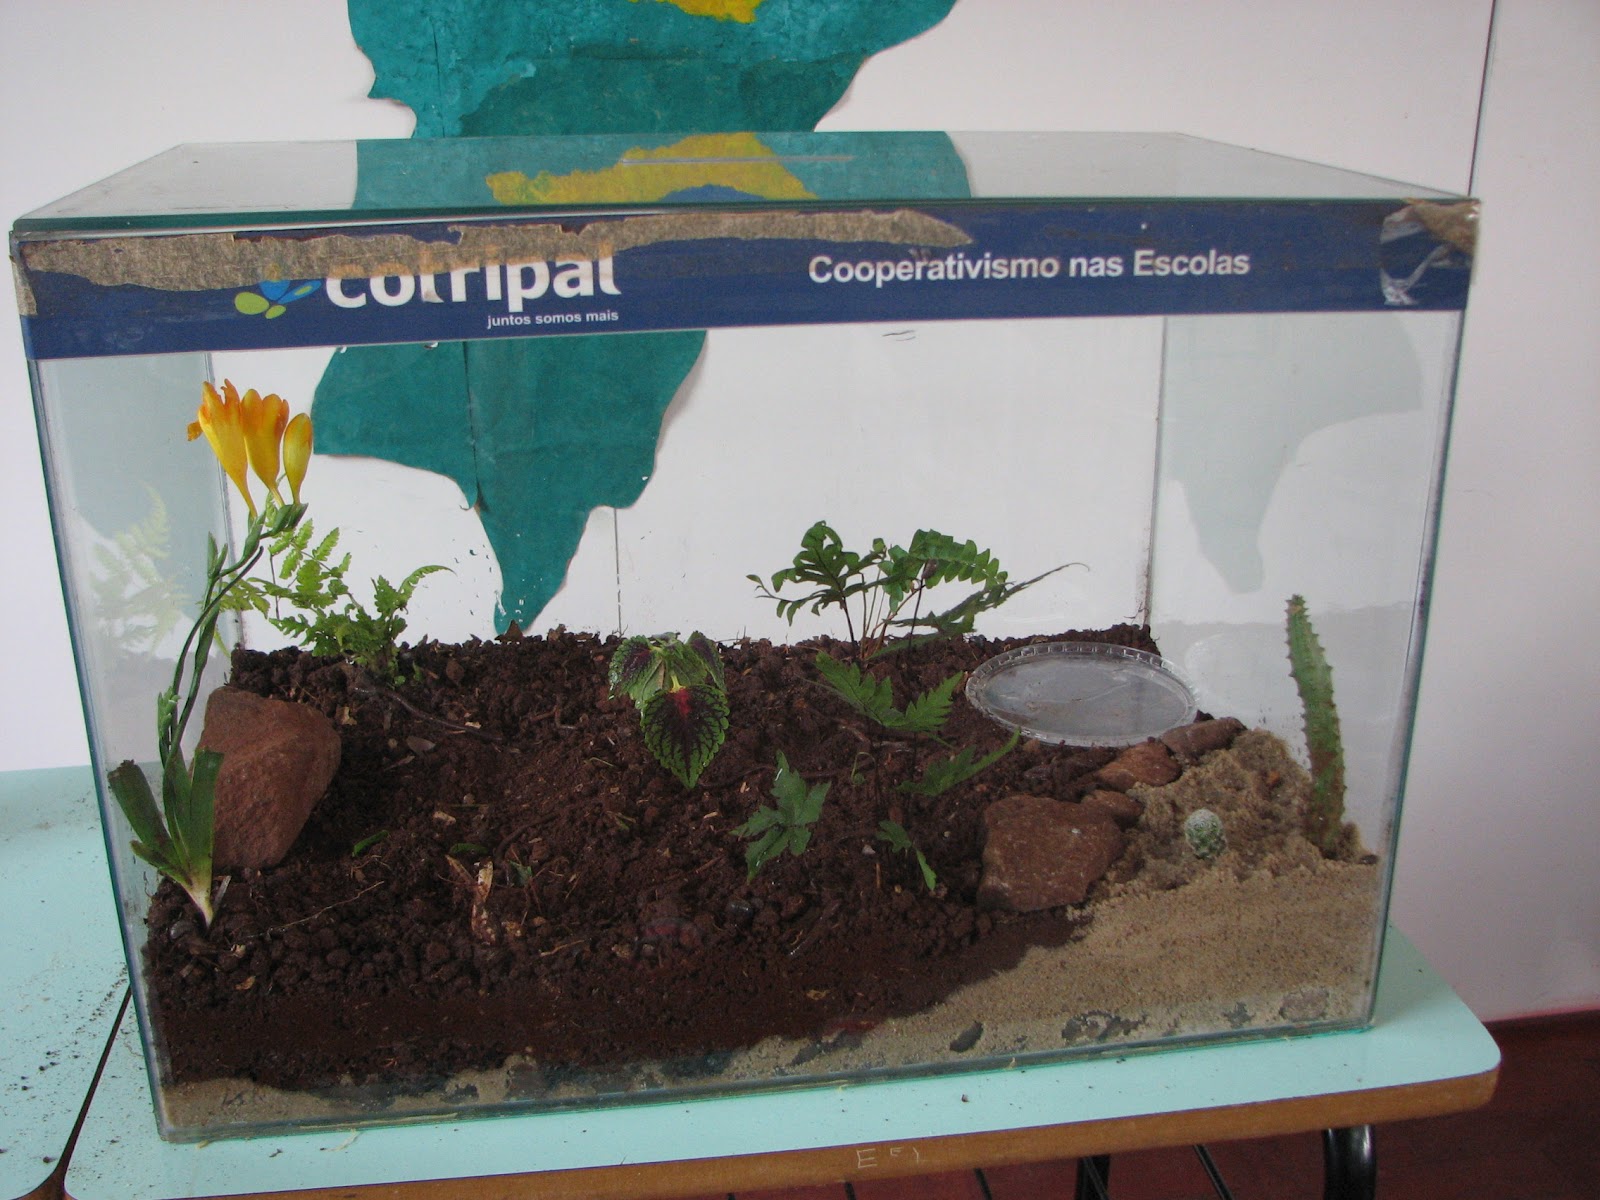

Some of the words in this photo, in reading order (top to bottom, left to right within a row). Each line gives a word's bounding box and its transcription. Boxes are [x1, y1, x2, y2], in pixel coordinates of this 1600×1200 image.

[808, 252, 1060, 288] Cooperativismo
[1068, 255, 1123, 278] nas
[1133, 249, 1251, 277] Escolas
[486, 314, 532, 330] juntos
[535, 313, 582, 325] somos
[586, 309, 619, 322] mais
